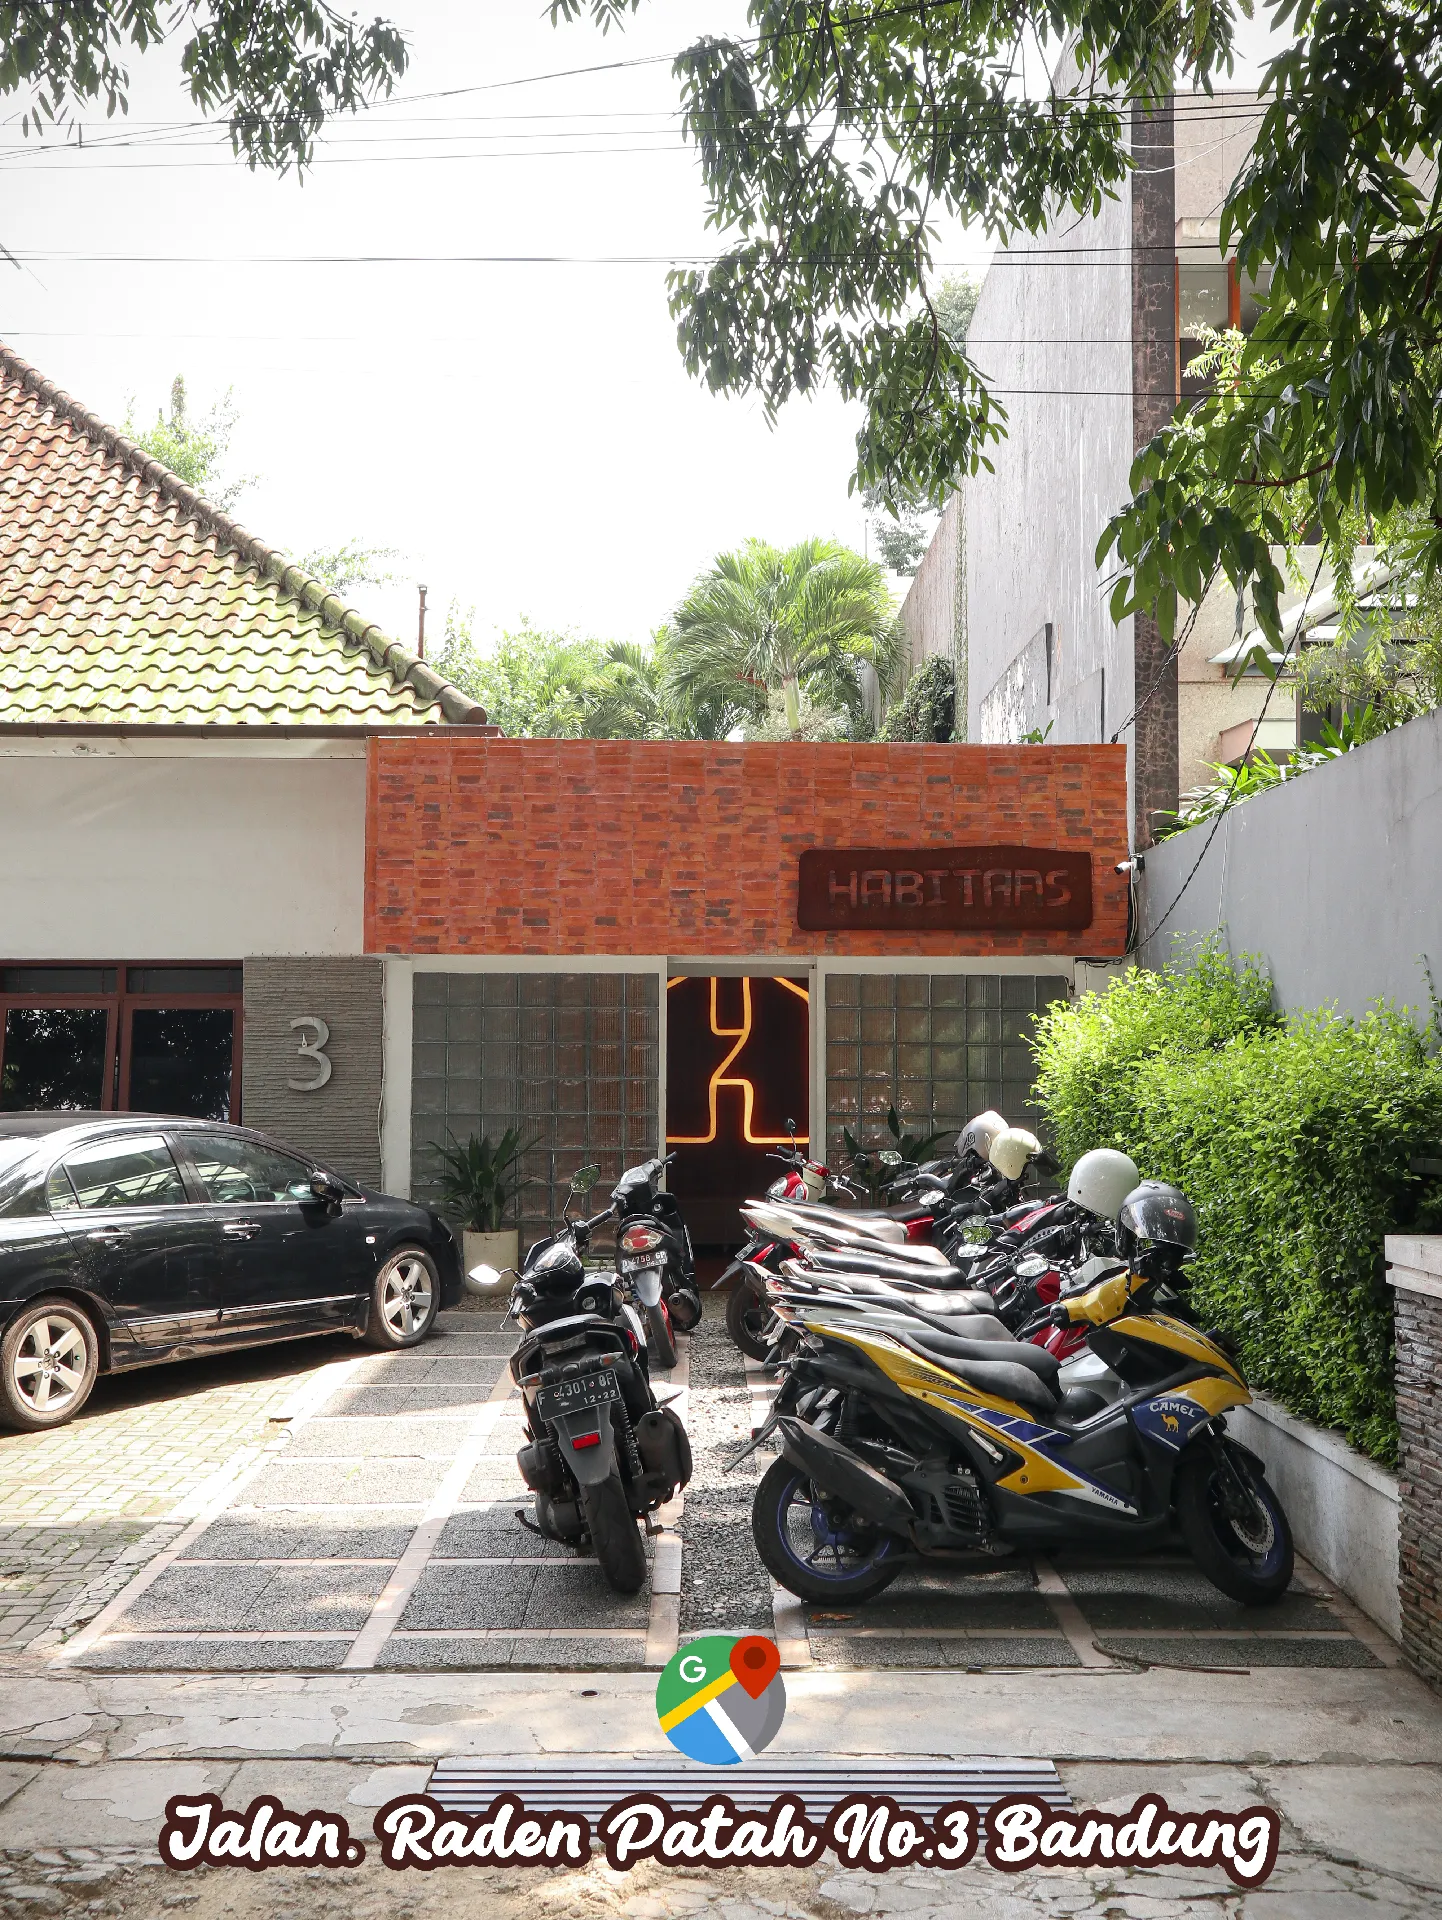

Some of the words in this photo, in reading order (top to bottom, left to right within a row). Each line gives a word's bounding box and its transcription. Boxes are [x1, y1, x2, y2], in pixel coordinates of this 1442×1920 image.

[287, 1016, 332, 1091] 3
[538, 1391, 546, 1405] F
[557, 1380, 587, 1398] 4301
[1150, 1402, 1195, 1417] CAMEL
[1091, 1487, 1118, 1505] YAMAHA
